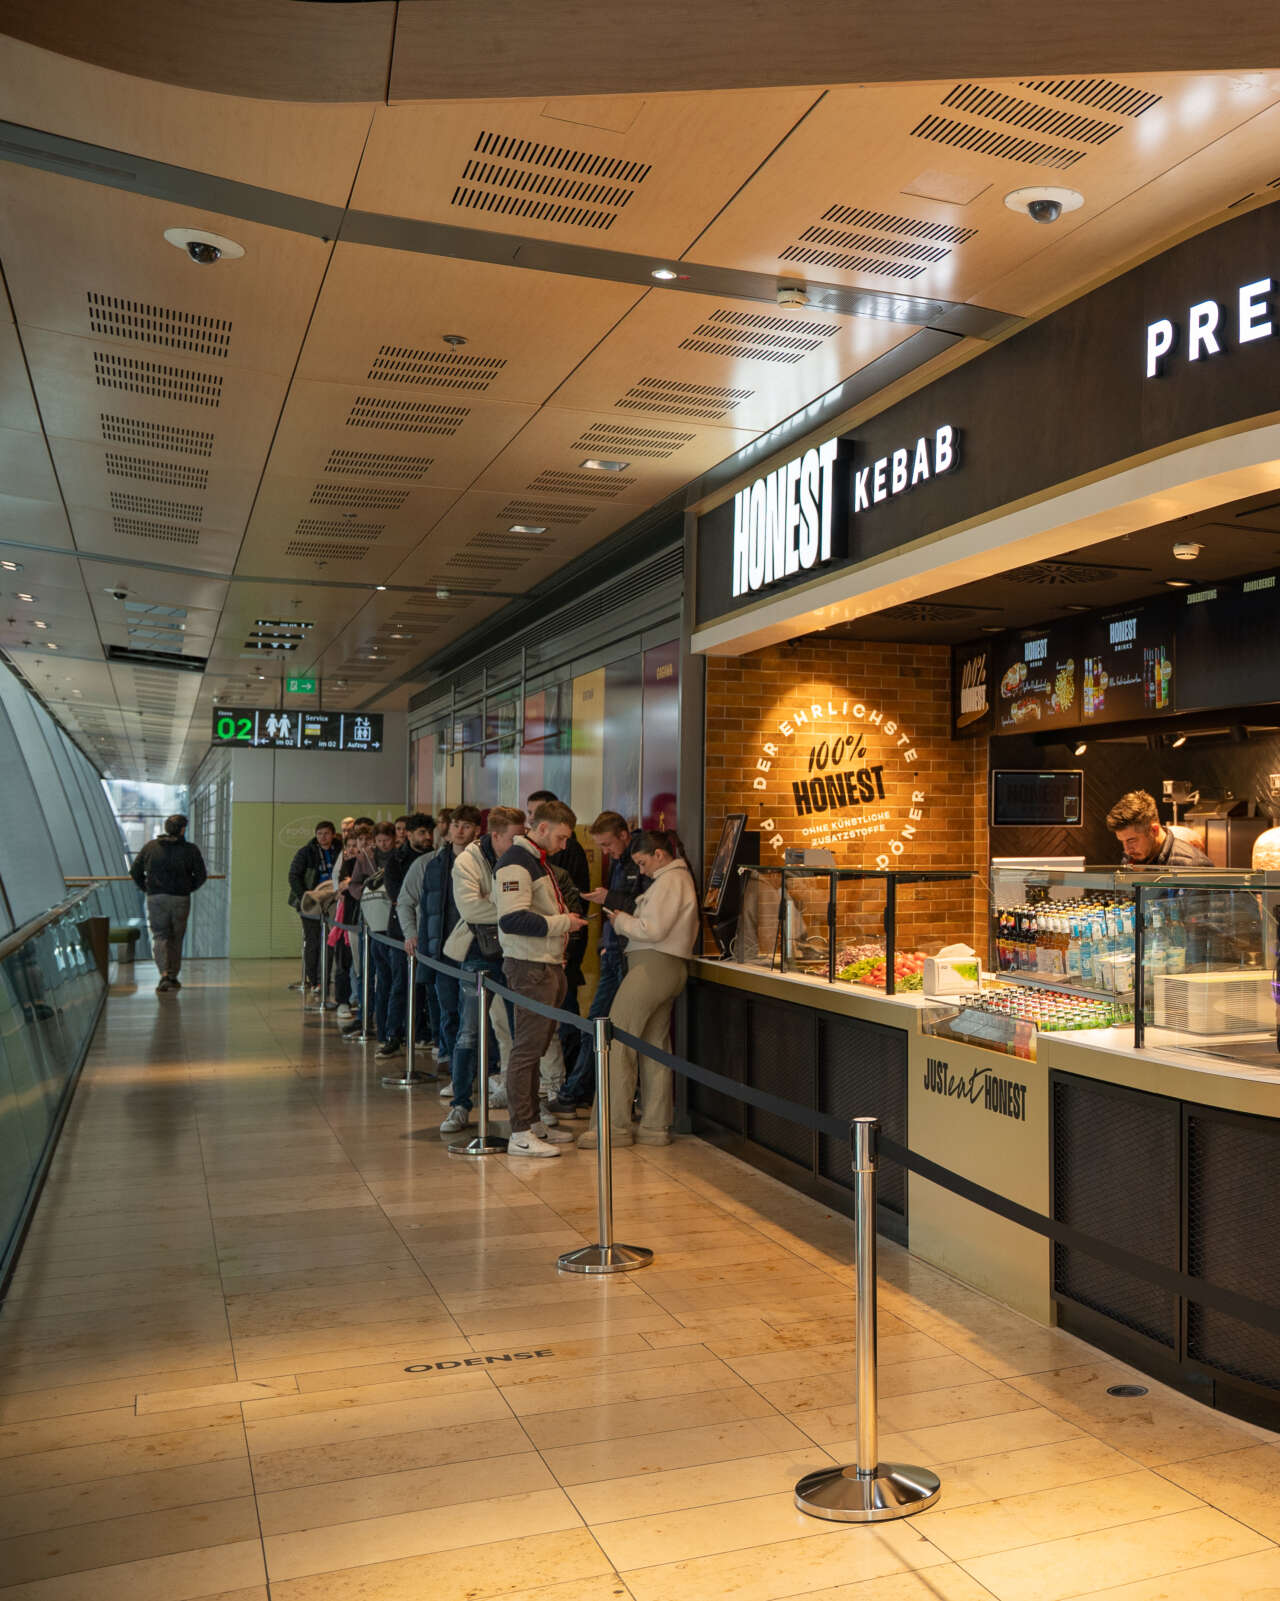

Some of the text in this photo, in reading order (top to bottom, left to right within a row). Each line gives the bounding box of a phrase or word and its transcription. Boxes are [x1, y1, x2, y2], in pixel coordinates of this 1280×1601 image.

[733, 424, 953, 598] HONEST KEBAB
[1110, 618, 1137, 645] HONEST
[216, 717, 253, 741] 02
[753, 701, 918, 791] DER EHRLICHSTE
[808, 732, 867, 774] 100%
[791, 764, 886, 817] HONEST
[801, 810, 891, 836] OHNE KÜNSTLICHE
[811, 823, 886, 847] ZUSATZSTOFFE
[875, 790, 926, 868] DÖNER
[923, 1057, 1027, 1122] JUST eat HONEST
[403, 1348, 556, 1374] ODENSE
